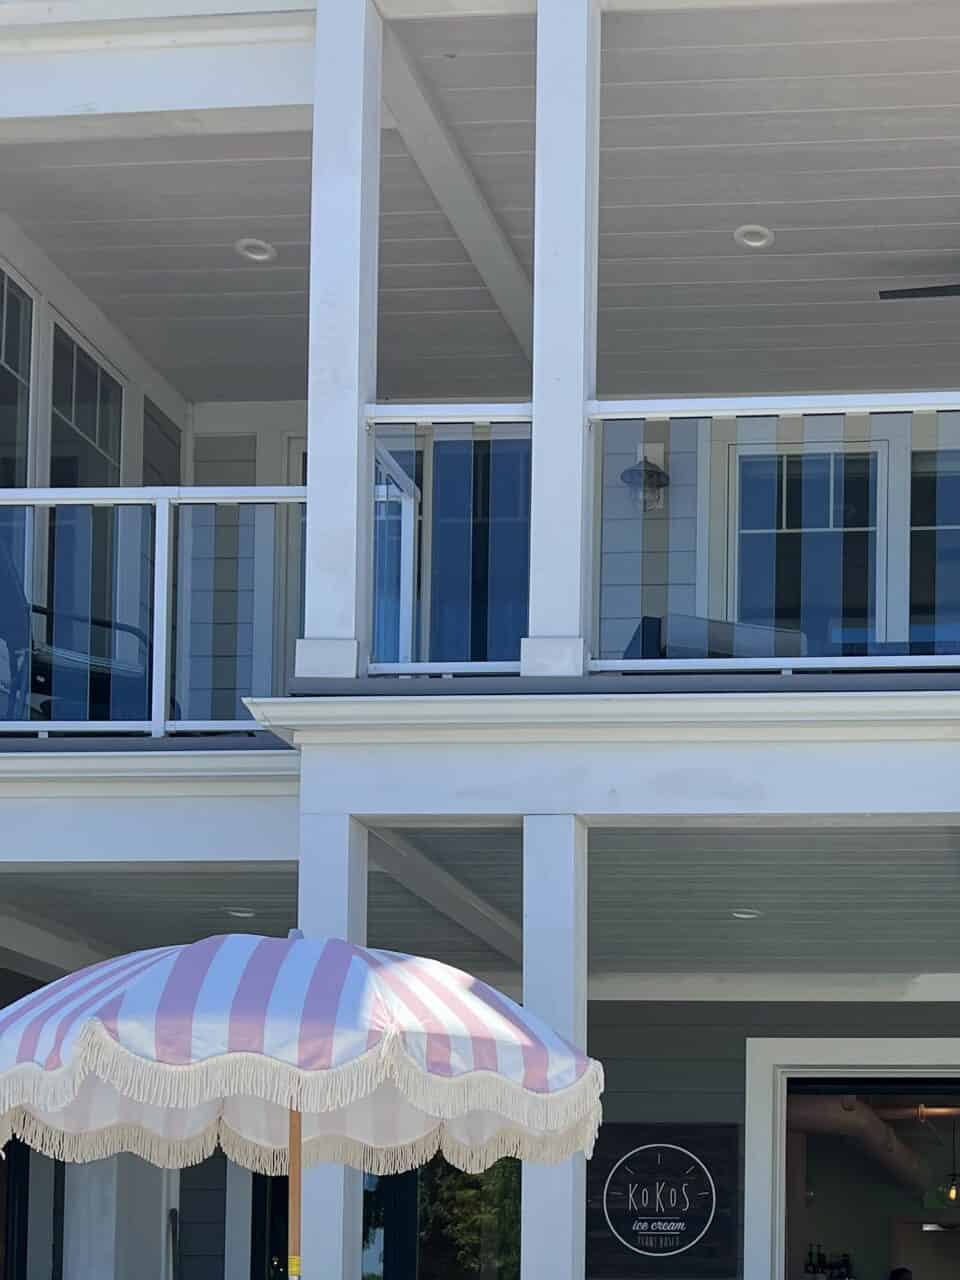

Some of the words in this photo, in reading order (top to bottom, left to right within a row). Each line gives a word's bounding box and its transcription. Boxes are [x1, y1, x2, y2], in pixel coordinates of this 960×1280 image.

[628, 1182, 690, 1212] KOKOS
[632, 1220, 649, 1230] ice
[651, 1221, 686, 1230] cream
